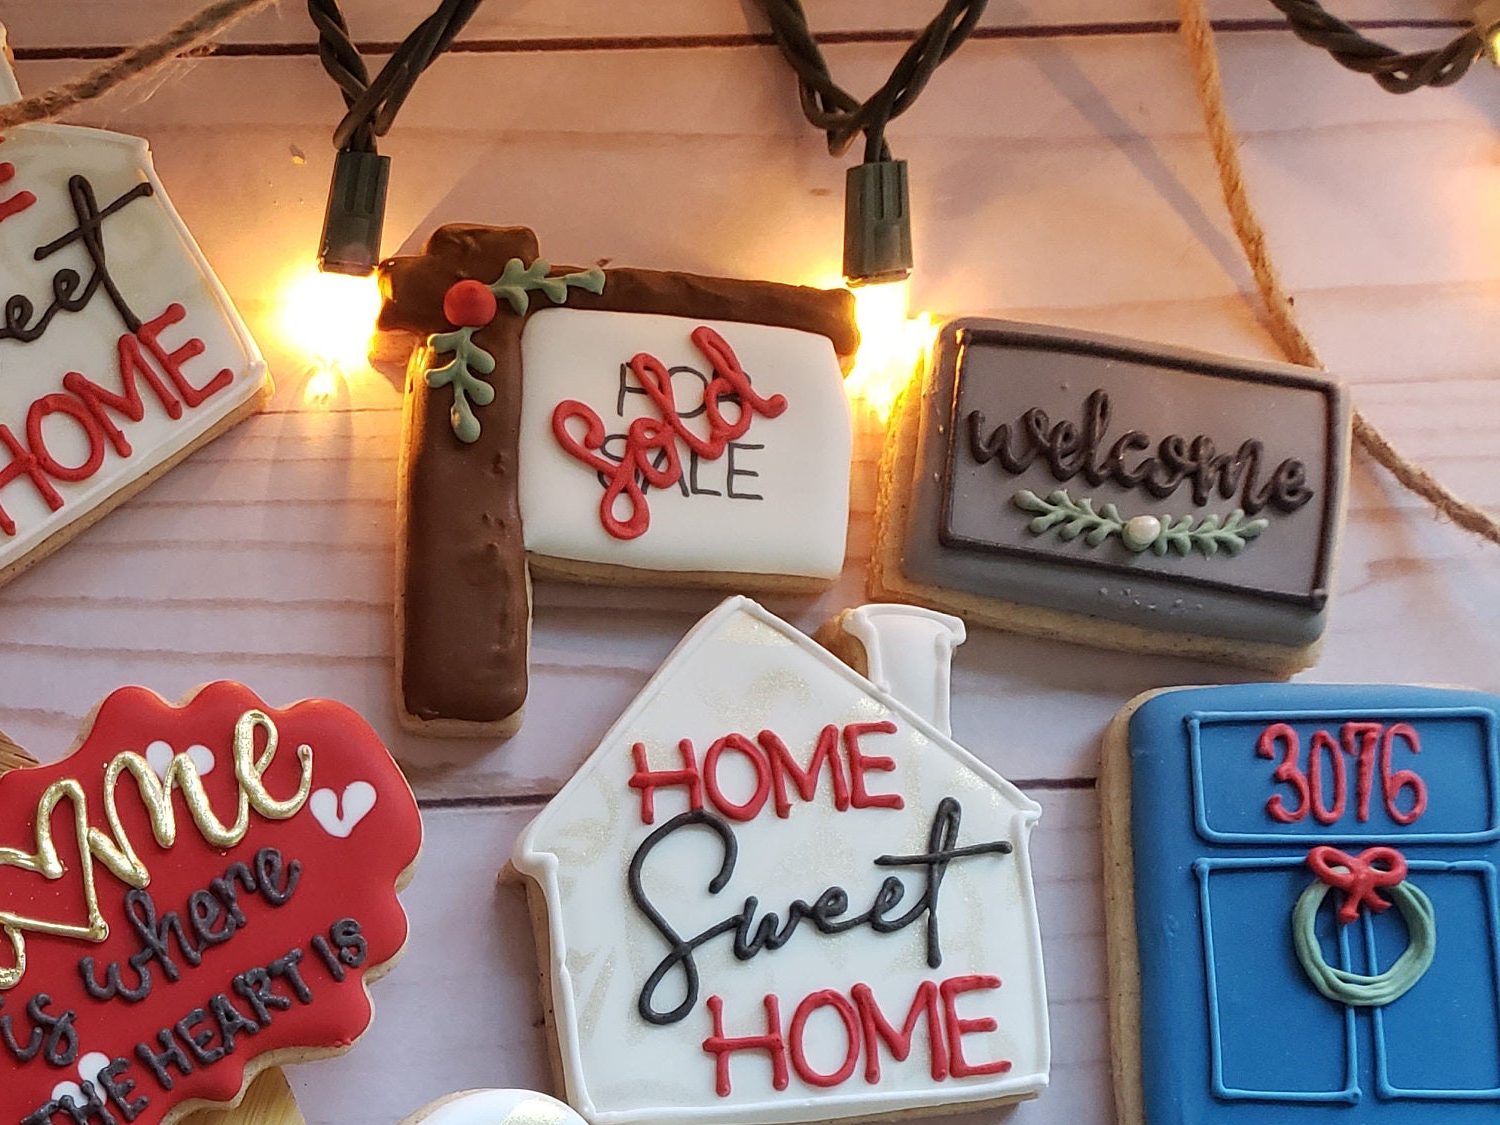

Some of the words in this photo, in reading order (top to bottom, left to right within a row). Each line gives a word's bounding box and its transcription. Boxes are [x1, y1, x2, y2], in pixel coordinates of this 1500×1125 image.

[968, 389, 1315, 514] welcome
[628, 721, 905, 824] HOME
[1257, 722, 1427, 825] 3076
[78, 848, 301, 1002] where
[628, 796, 1012, 1025] Sweet
[135, 948, 313, 1090] HEART
[312, 918, 368, 982] IS
[702, 975, 1012, 1097] HOME
